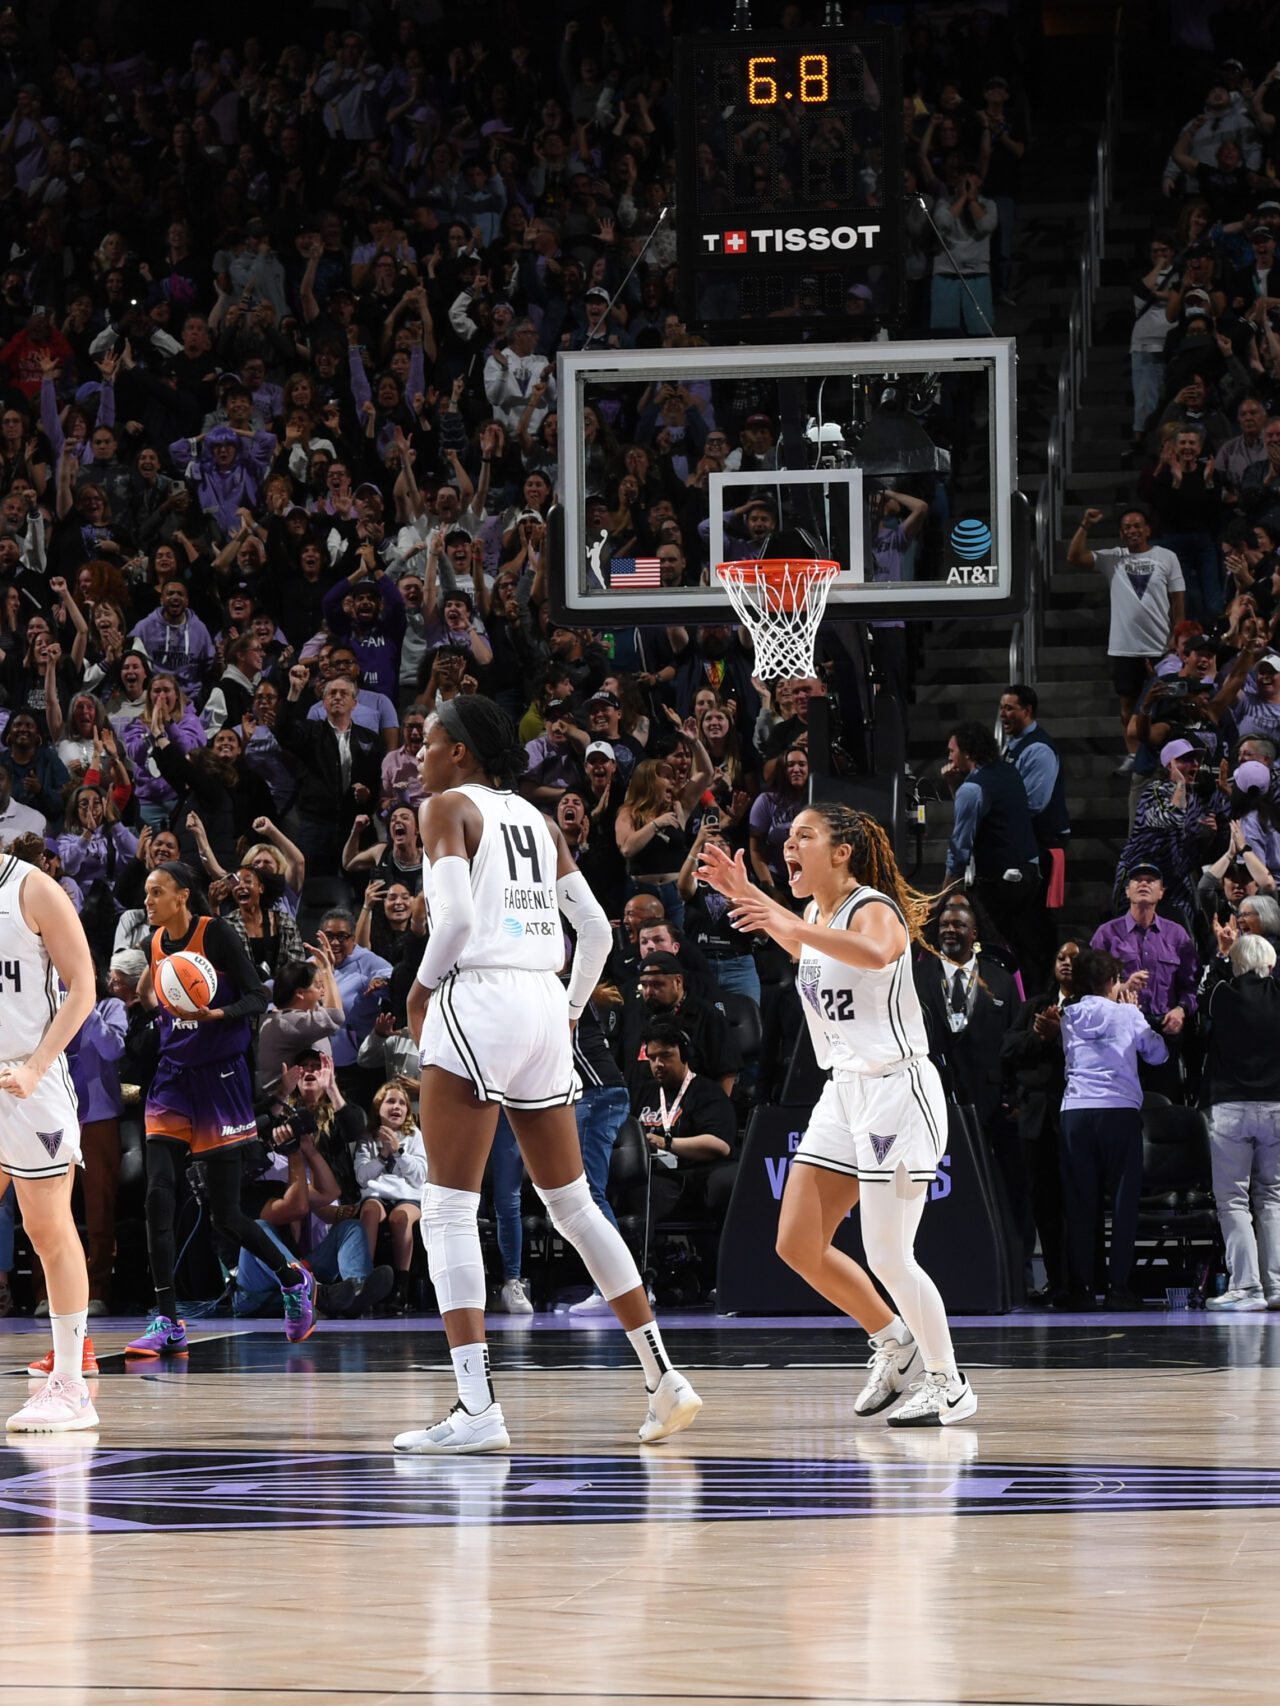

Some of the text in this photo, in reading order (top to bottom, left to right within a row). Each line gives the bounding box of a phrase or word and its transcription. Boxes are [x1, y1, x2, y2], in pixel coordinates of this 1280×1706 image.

[749, 54, 828, 104] 6.8
[751, 225, 880, 252] TISSOT
[946, 565, 998, 584] AT&T
[500, 822, 541, 883] 14
[525, 921, 556, 935] AT&T
[821, 988, 856, 1021] 22
